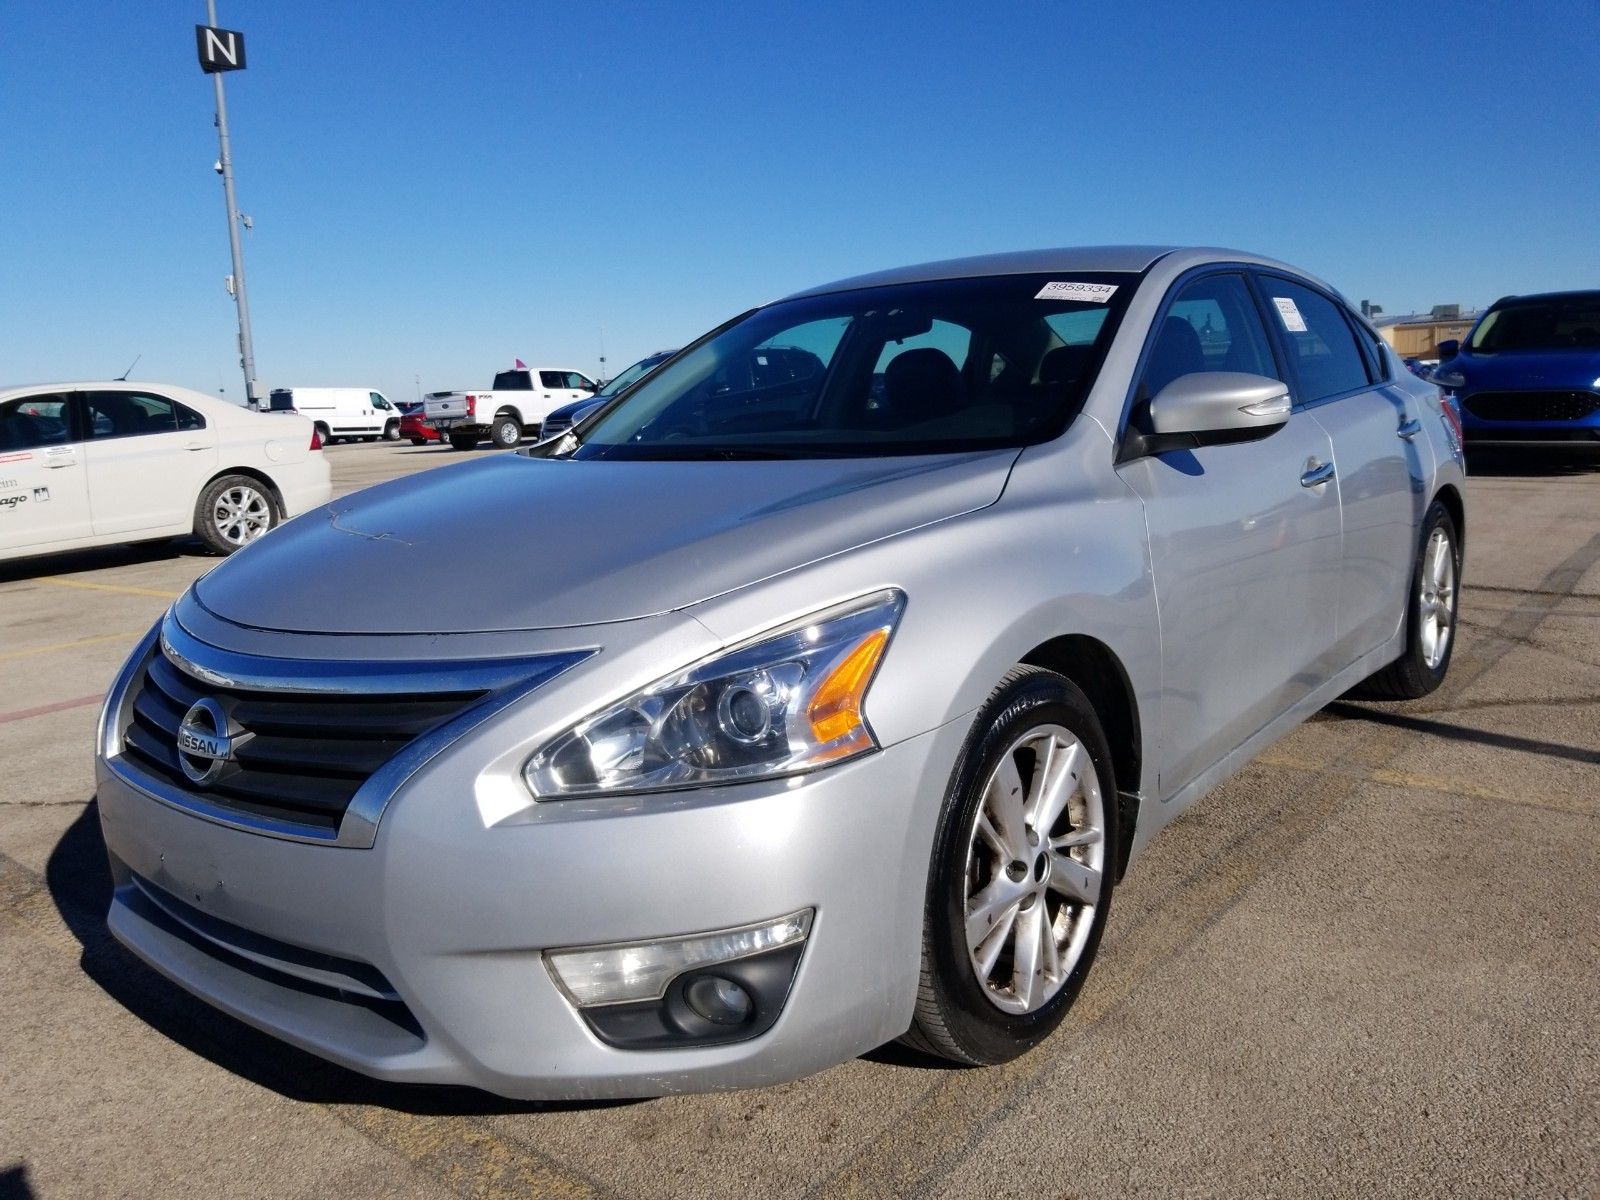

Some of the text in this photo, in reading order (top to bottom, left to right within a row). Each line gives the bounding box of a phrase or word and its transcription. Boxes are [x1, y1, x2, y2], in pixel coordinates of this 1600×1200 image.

[206, 29, 237, 65] N
[1047, 283, 1112, 293] 3959334
[179, 731, 218, 755] NISSAN
